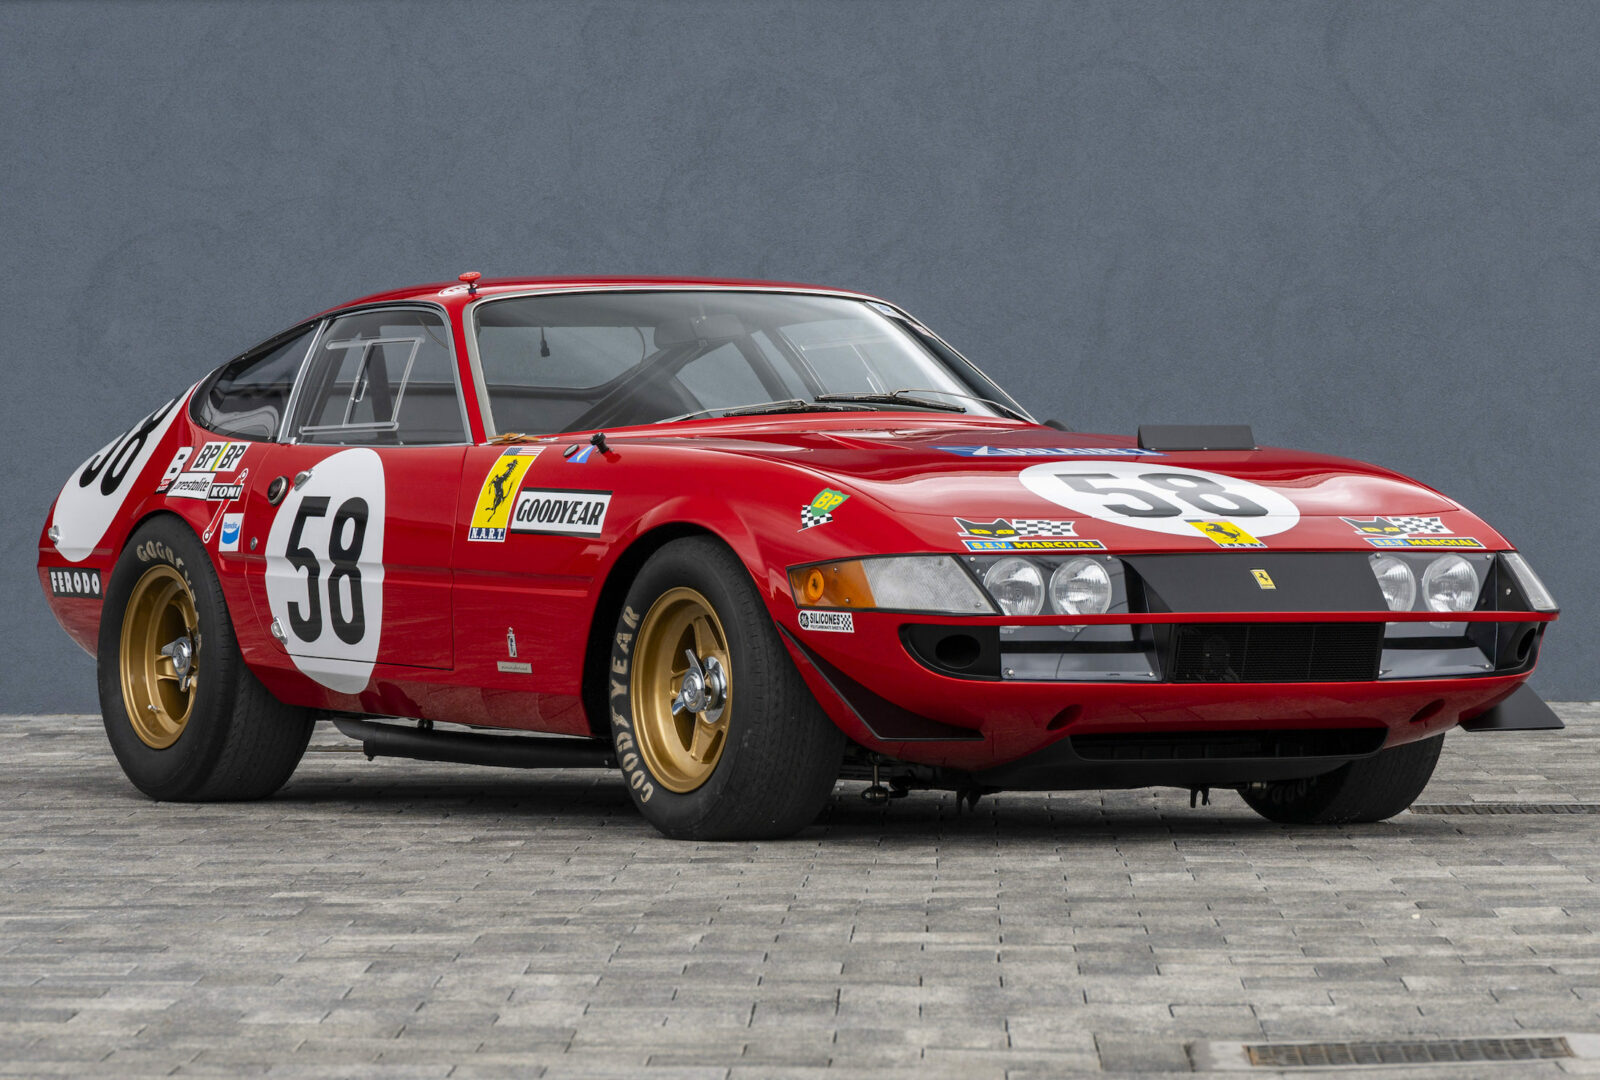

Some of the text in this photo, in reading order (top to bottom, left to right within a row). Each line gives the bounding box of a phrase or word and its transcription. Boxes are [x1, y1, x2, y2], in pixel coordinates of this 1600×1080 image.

[193, 445, 247, 469] BP BP
[211, 486, 241, 497] KONI
[813, 491, 844, 510] BP
[1054, 473, 1269, 518] 58
[516, 498, 605, 525] GOODYEAR
[470, 528, 504, 541] N.A.R.T.
[1013, 541, 1100, 549] MARCHAL
[285, 496, 369, 645] 58
[50, 571, 100, 595] FERODO
[809, 612, 841, 625] SILICONES
